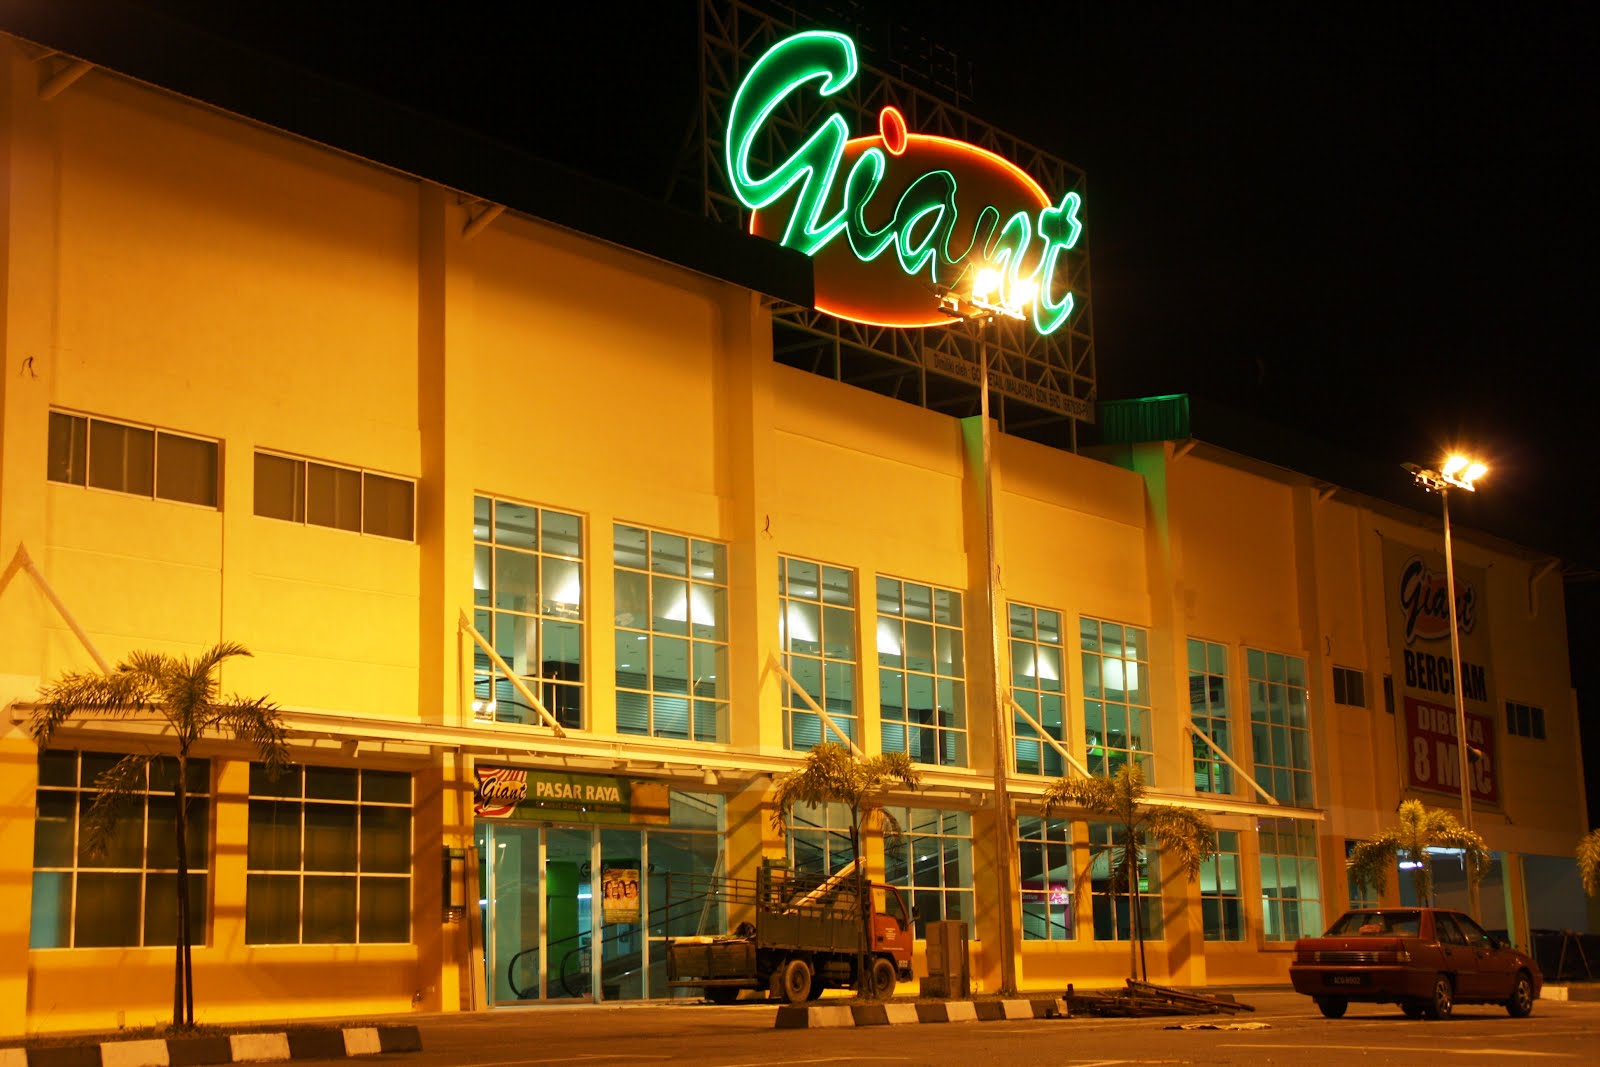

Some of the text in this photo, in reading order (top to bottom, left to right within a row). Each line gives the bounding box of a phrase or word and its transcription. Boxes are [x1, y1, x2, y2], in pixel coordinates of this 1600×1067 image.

[726, 30, 1082, 336] Giant
[1413, 736, 1431, 782] 8
[481, 774, 527, 809] Giant
[536, 781, 621, 802] PASAR RAYA
